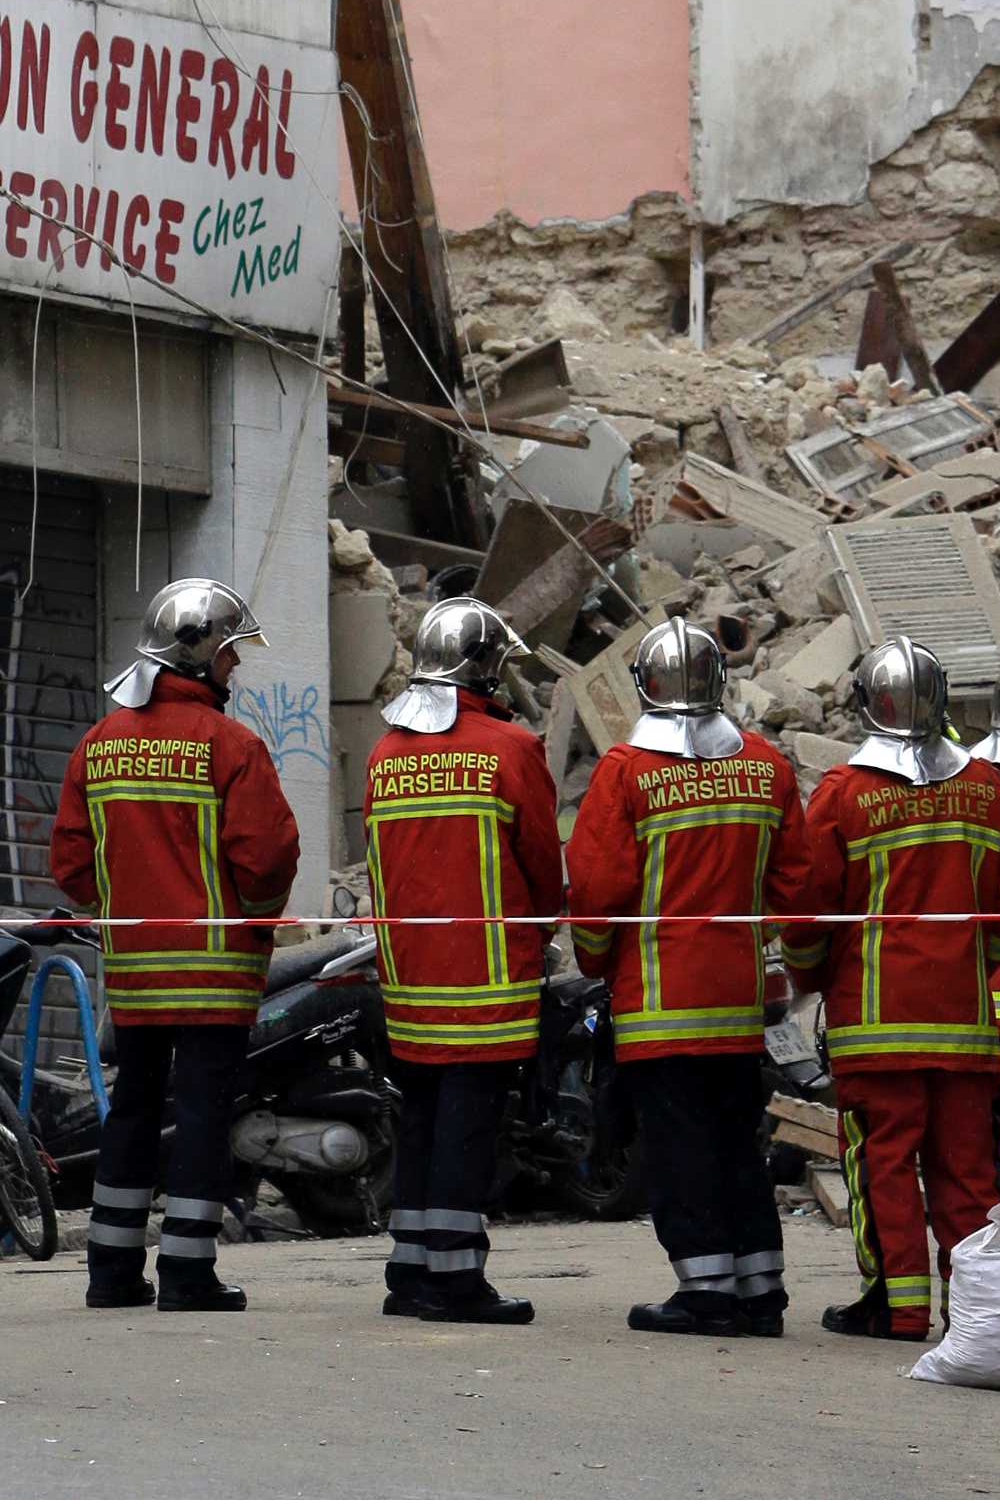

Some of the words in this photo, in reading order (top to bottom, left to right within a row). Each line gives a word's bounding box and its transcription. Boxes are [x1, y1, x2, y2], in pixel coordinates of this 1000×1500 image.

[71, 31, 295, 179] GENERAL
[0, 170, 185, 284] ERVICE
[193, 197, 267, 256] Chez
[230, 225, 302, 298] Med
[86, 739, 137, 758] MARINS
[139, 739, 211, 759] POMPIERS
[421, 752, 499, 771] POMPIERS
[87, 757, 209, 781] MARSEILLE
[637, 763, 698, 791] MARINS
[701, 759, 775, 778] POMPIERS
[648, 777, 773, 810] MARSEILLE
[857, 785, 919, 809] MARINS
[868, 797, 989, 827] MARSEILLE
